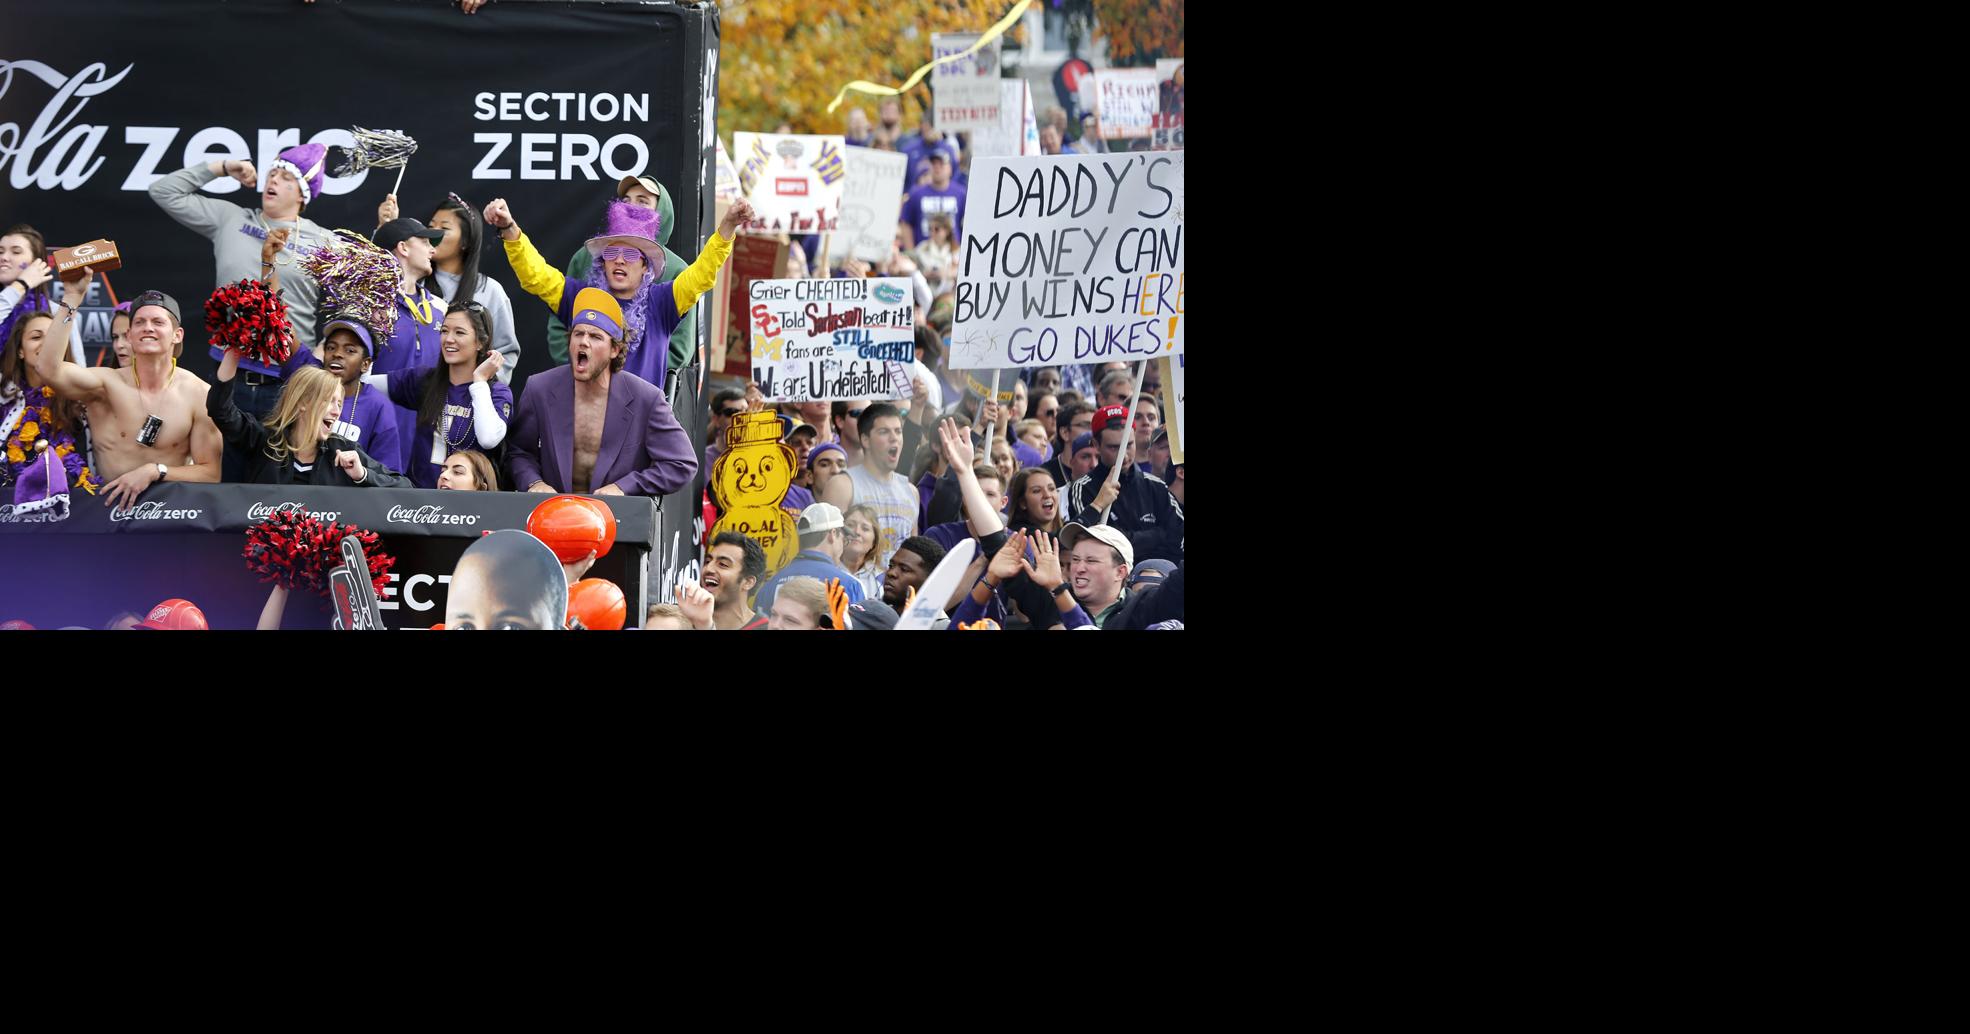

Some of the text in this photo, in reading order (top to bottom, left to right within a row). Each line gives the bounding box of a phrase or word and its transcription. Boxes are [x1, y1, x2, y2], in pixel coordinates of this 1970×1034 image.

[473, 91, 650, 122] SECTION
[121, 126, 370, 195] zero
[471, 132, 650, 181] ZERO
[994, 155, 1173, 219] DADDY'S
[74, 256, 92, 267] CALL
[92, 251, 115, 261] BRICK
[964, 225, 1182, 278] MONEY CAN
[750, 279, 868, 300] Grier CHEATED!
[955, 281, 1011, 323] BUY
[1022, 276, 1115, 320] WINS
[777, 311, 806, 329] Told
[863, 307, 890, 326] beat
[785, 340, 810, 359] fans
[812, 345, 834, 357] are
[833, 329, 873, 346] STILL
[1008, 316, 1179, 364] GO DUKES!
[809, 360, 890, 399] Undefeated!
[110, 501, 168, 522] Coca-Cola
[386, 504, 445, 525] Coca-Cola
[732, 520, 778, 534] LOAL
